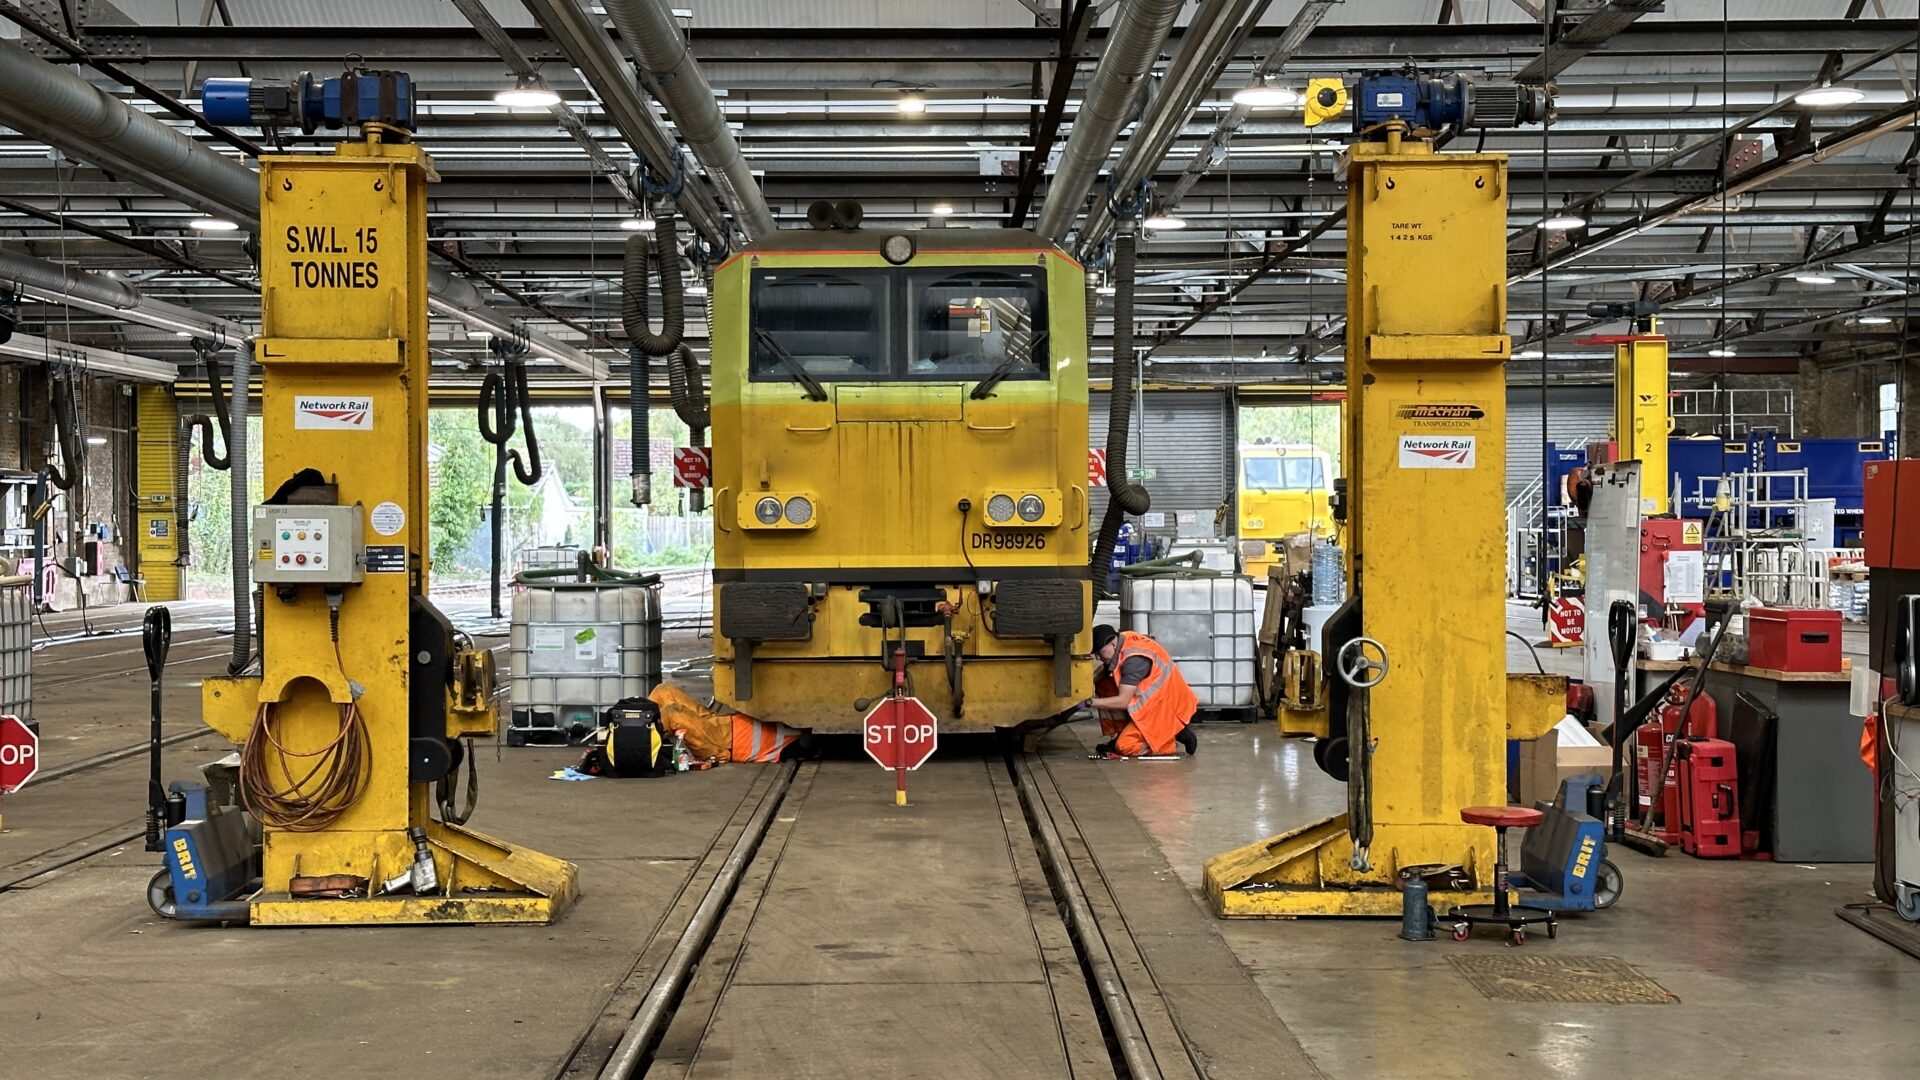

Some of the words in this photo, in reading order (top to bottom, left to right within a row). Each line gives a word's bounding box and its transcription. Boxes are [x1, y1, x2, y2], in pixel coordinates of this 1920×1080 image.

[286, 225, 348, 253] S.W.L.
[355, 227, 378, 253] 15
[290, 261, 379, 289] TONNES
[300, 401, 346, 410] Network
[348, 401, 369, 410] Rail
[1403, 440, 1448, 449] Network
[1451, 440, 1471, 449] Rail
[1645, 443, 1652, 453] 2
[972, 533, 1046, 550] DR98926
[1560, 610, 1571, 618] NOT
[1560, 627, 1582, 635] MOVED
[867, 724, 934, 744] STOP
[0, 744, 34, 765] OP
[173, 837, 198, 880] BRIT
[1572, 834, 1597, 879] BRIT
